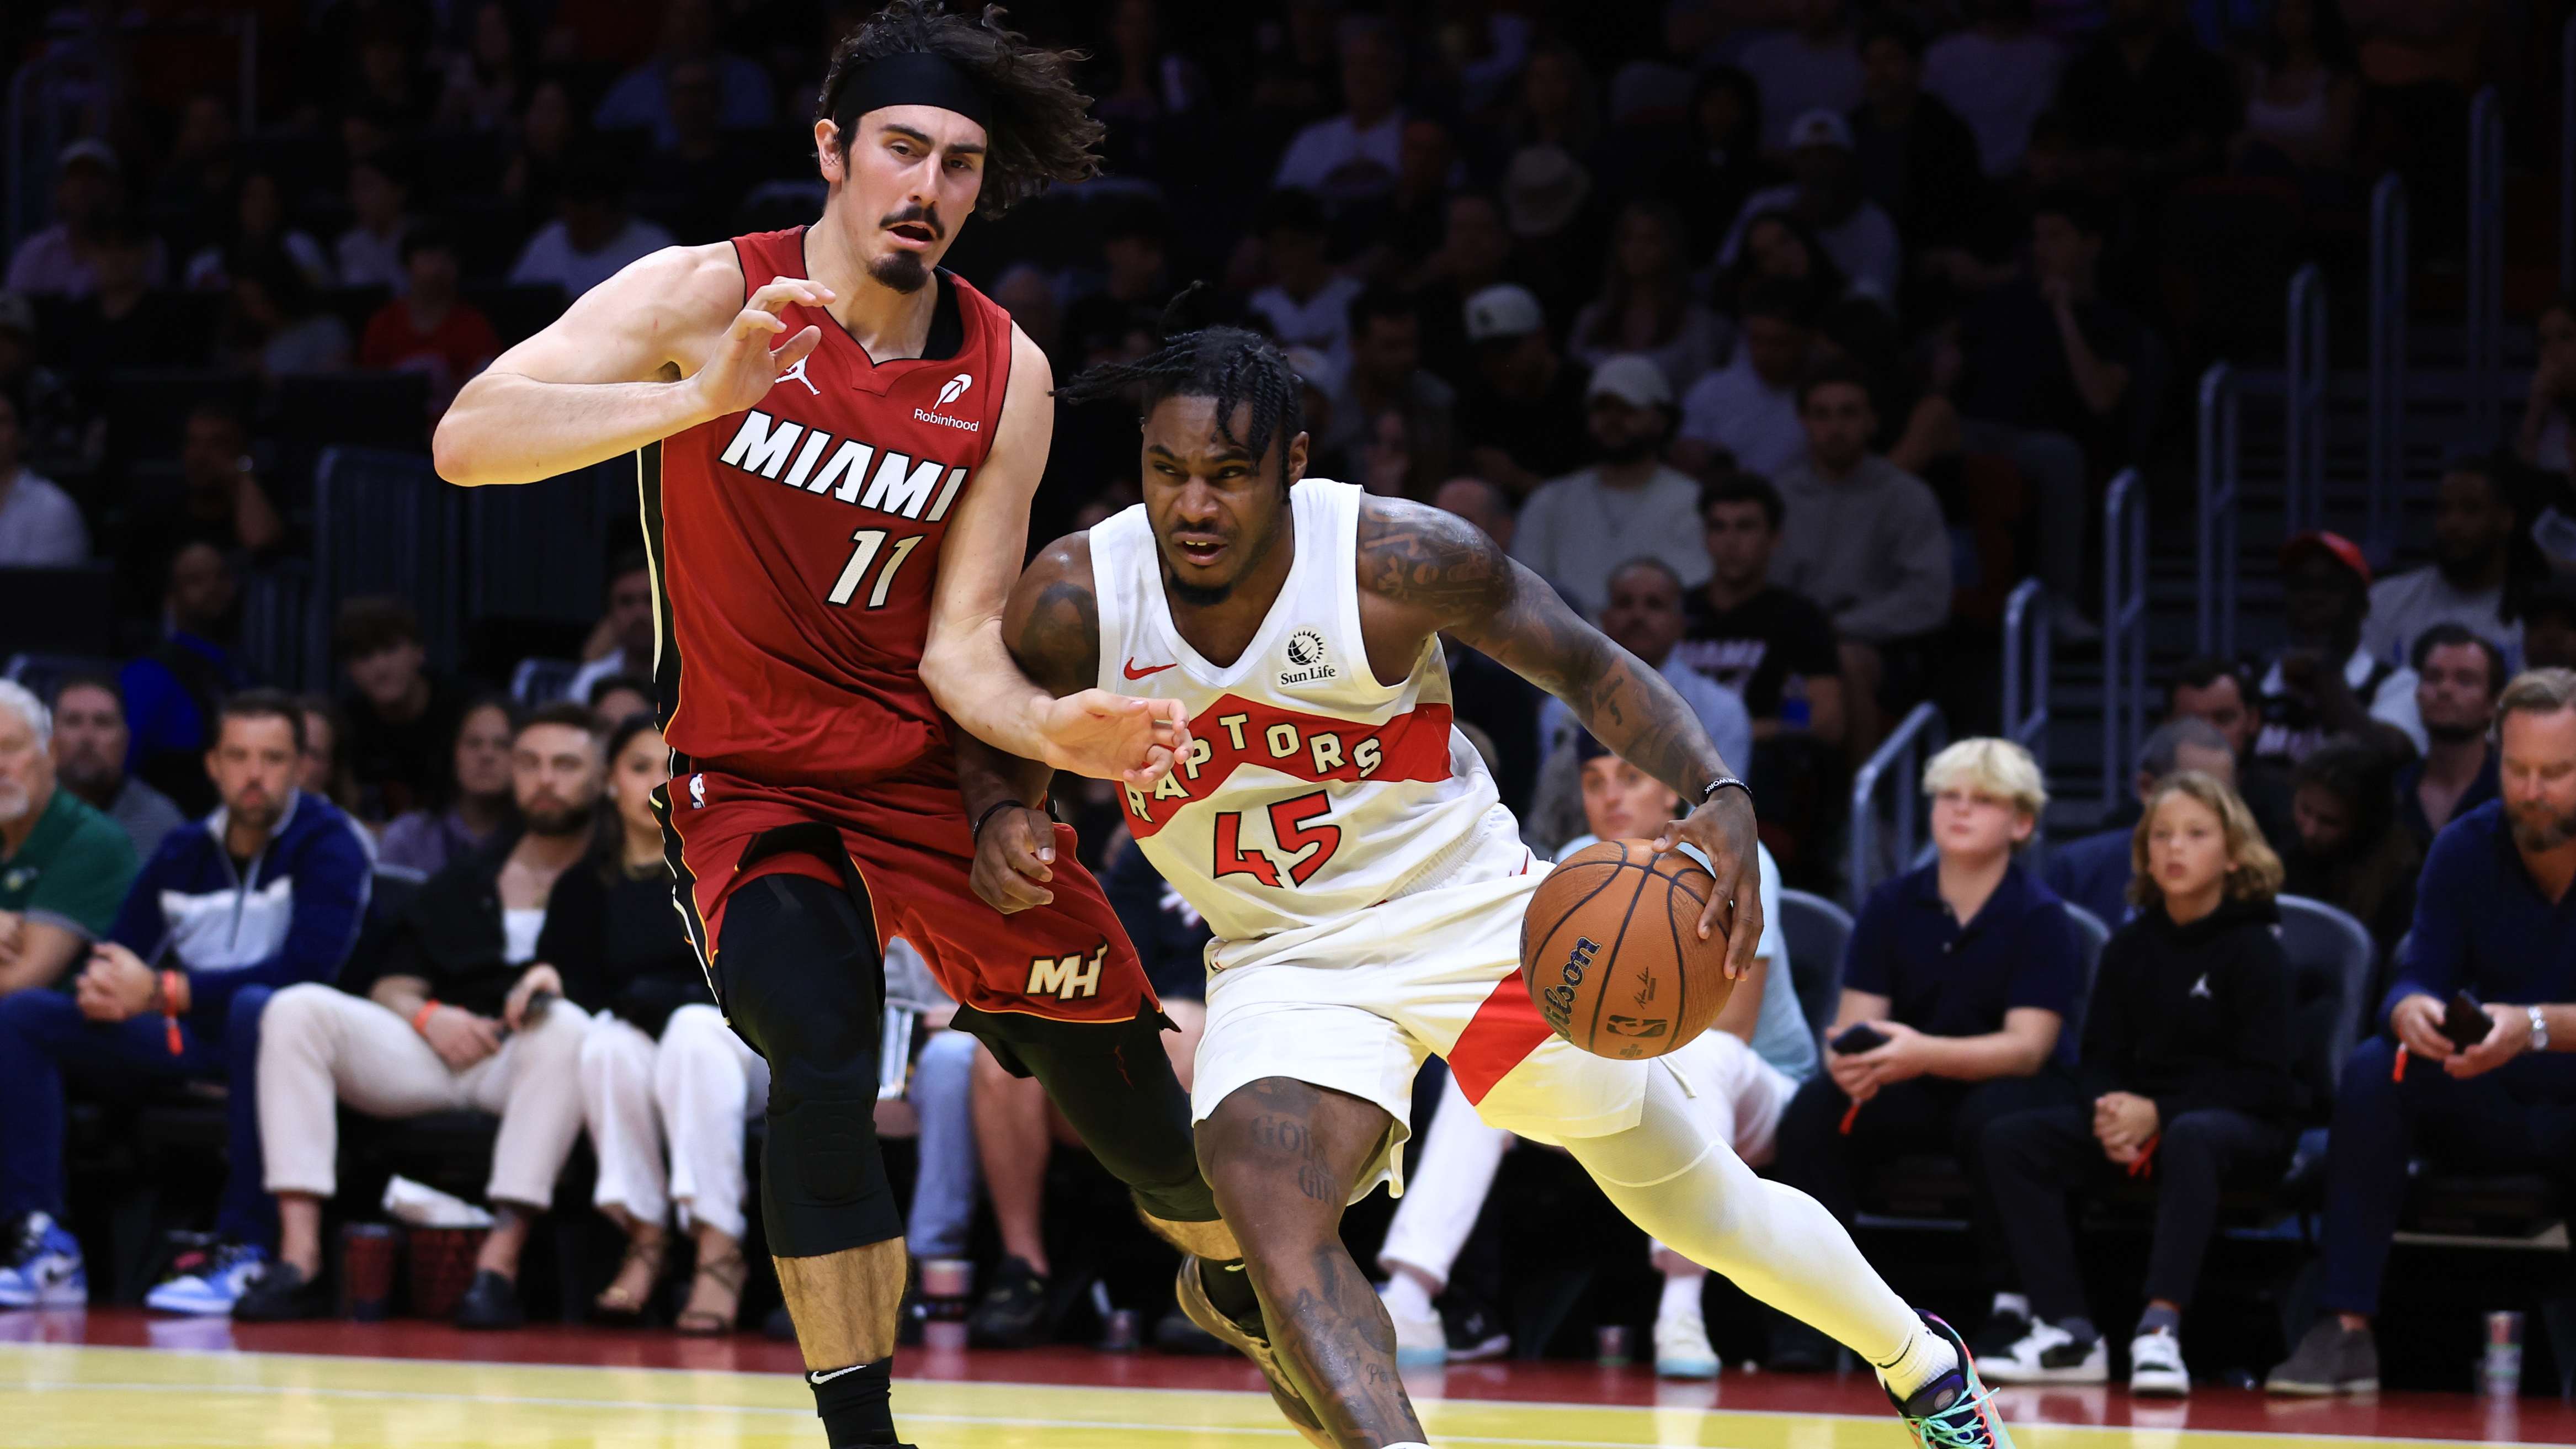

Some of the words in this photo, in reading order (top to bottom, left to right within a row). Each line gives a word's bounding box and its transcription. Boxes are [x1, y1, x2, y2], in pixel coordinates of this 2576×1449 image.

[914, 408, 980, 432] Robinhood
[719, 408, 968, 522] MIAMI
[825, 528, 927, 608] 11
[1280, 672, 1308, 685] Sun
[1309, 665, 1337, 680] Life
[1123, 713, 1382, 823] RAPTORS
[1704, 778, 1728, 794] WORK
[1214, 789, 1342, 888] 45
[1026, 942, 1109, 1001] MH
